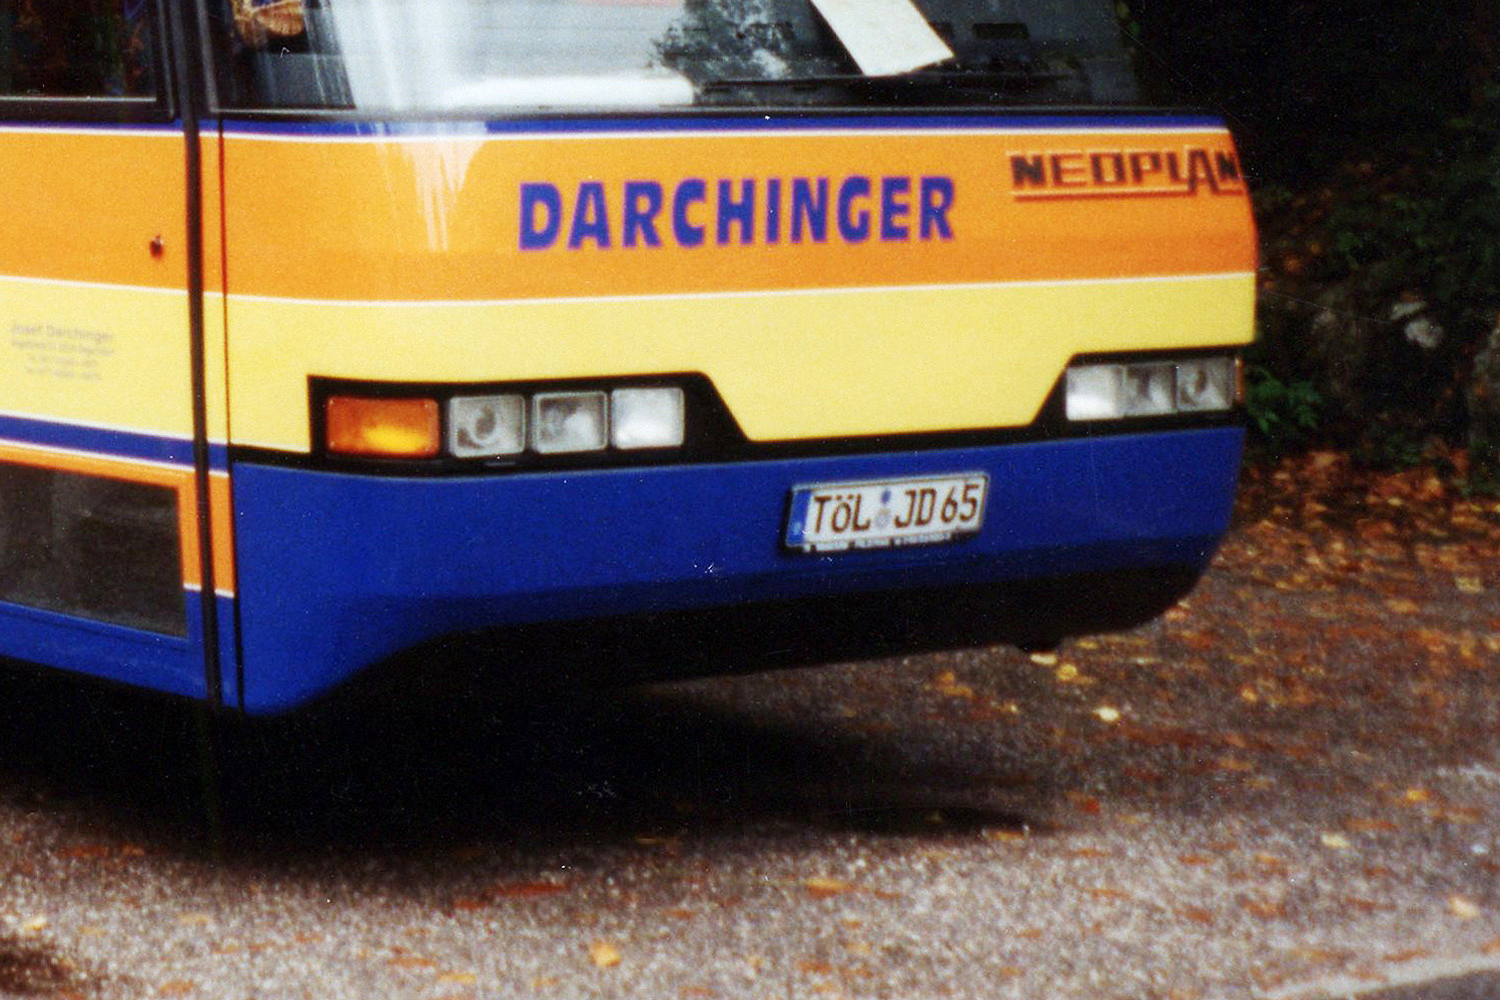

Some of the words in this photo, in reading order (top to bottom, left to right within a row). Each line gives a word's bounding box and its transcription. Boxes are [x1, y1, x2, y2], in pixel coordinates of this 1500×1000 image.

[1006, 146, 1243, 198] NEOPLAN
[517, 175, 956, 252] DARCHINGER
[812, 493, 871, 534] TÖL
